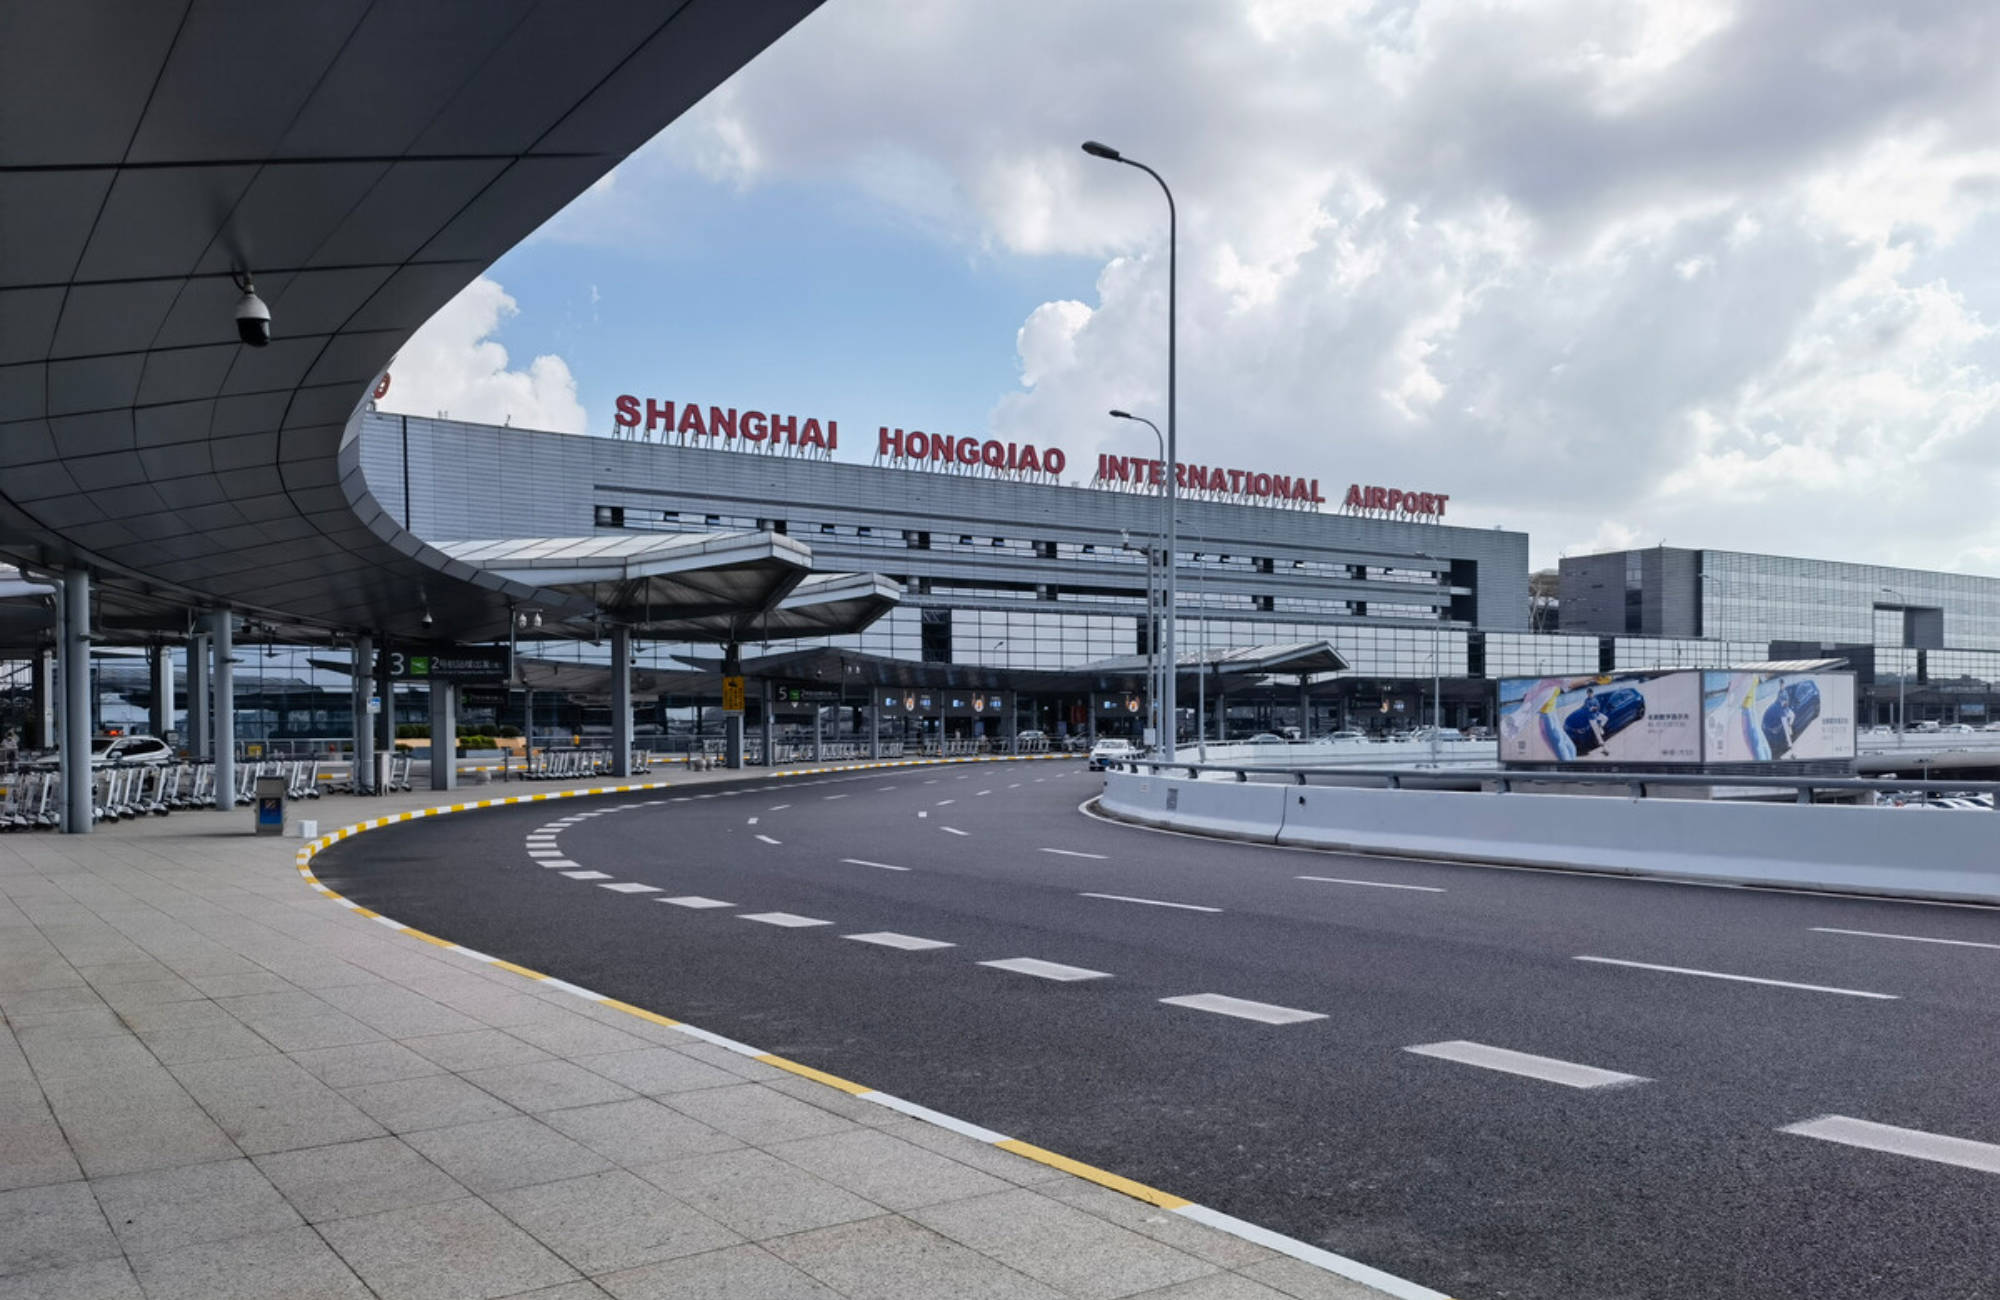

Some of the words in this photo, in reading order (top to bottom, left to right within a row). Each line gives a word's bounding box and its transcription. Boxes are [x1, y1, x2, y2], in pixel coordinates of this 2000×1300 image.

[614, 394, 838, 449] SHANGHAI
[879, 426, 1066, 475] HONGQIAO
[1098, 453, 1326, 503] INTERNATIONAL
[1346, 484, 1450, 516] AIRPORT
[390, 652, 405, 676] 3
[779, 686, 788, 701] 5
